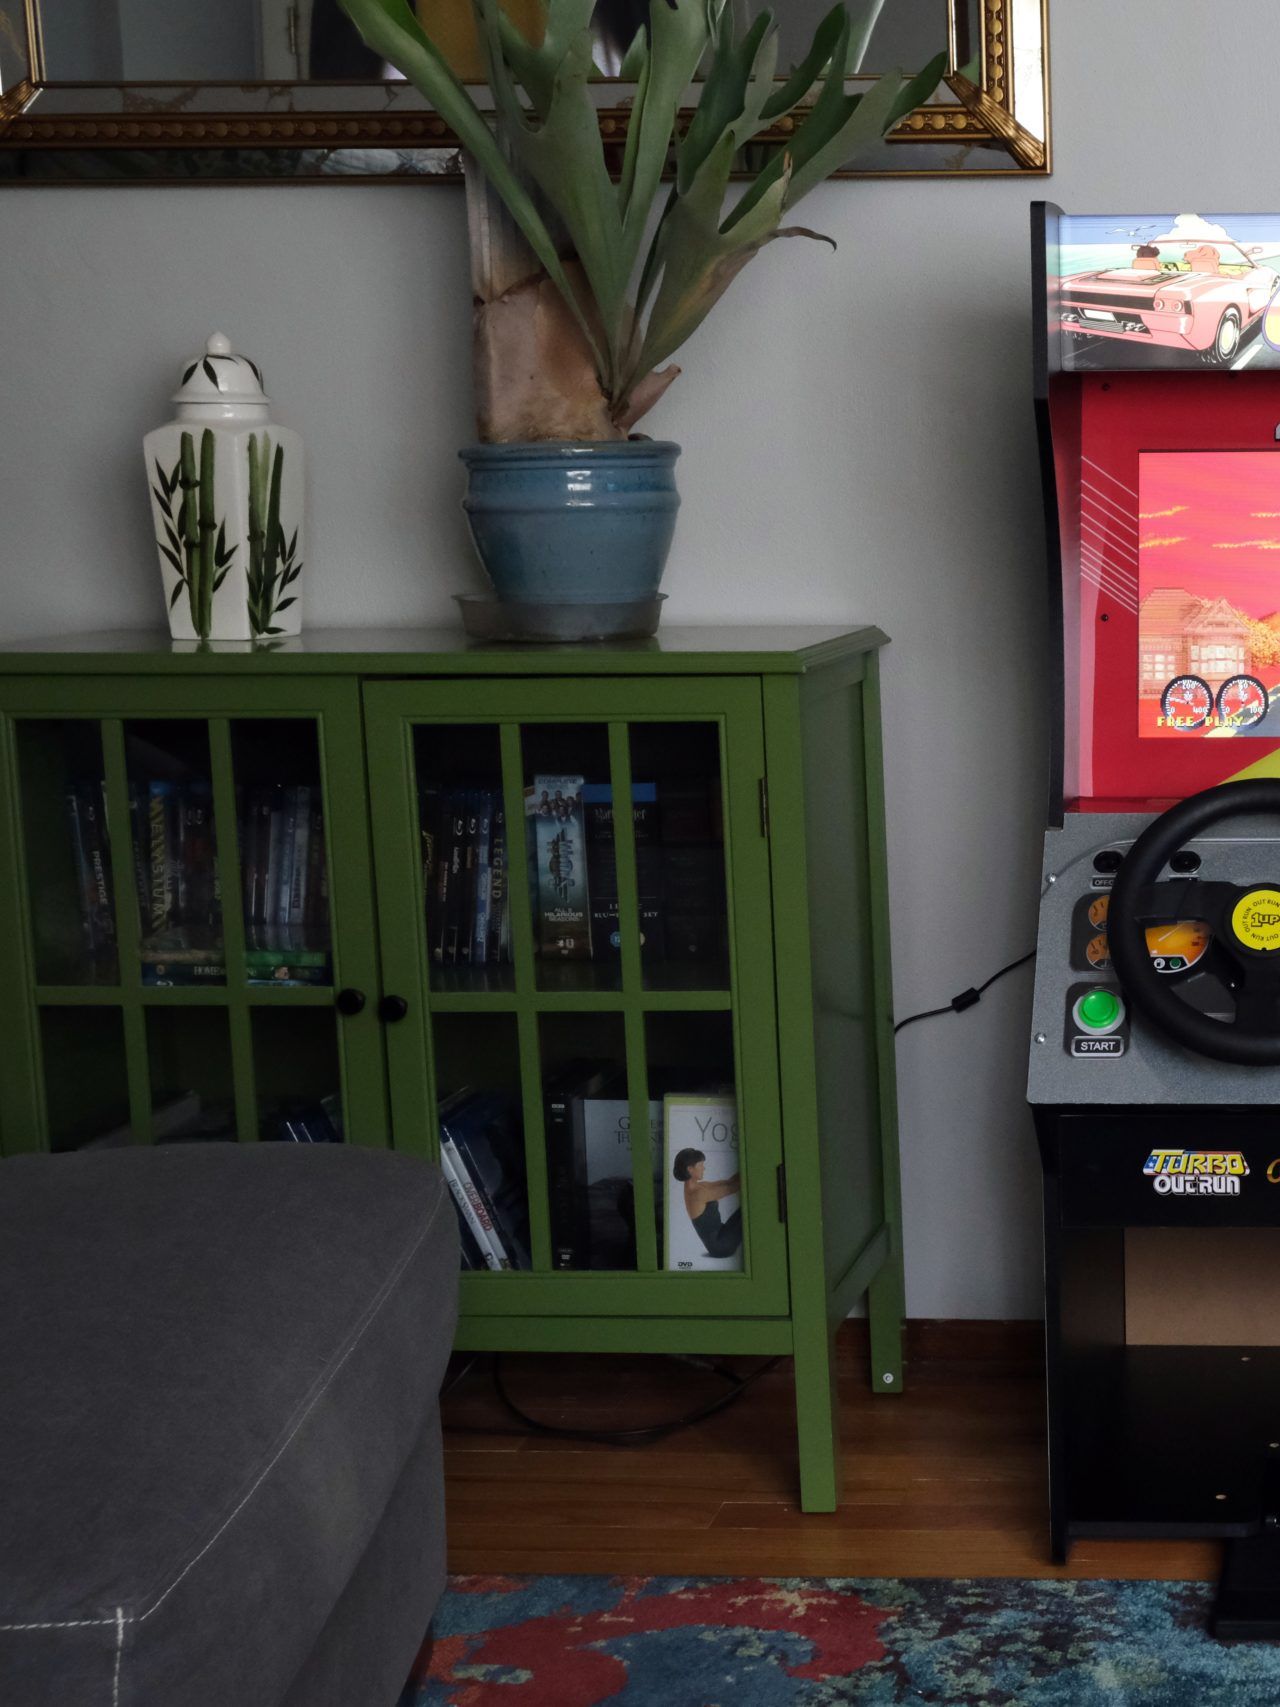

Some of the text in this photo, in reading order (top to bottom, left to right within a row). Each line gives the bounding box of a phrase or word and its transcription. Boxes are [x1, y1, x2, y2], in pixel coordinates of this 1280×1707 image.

[1157, 716, 1244, 727] FREE PLAY
[492, 838, 505, 900] LEGEND
[91, 850, 108, 905] PRESTIGE
[1252, 898, 1266, 907] OUT
[1267, 899, 1280, 908] RUN
[1242, 906, 1252, 920] RUN
[1250, 912, 1280, 927] 1UP
[1242, 921, 1250, 933] OUT
[1251, 932, 1265, 941] RUN
[1266, 933, 1279, 941] OUT
[1080, 1041, 1116, 1051] START
[1151, 1149, 1247, 1174] TURBO
[464, 1182, 492, 1232] OVERBOARD
